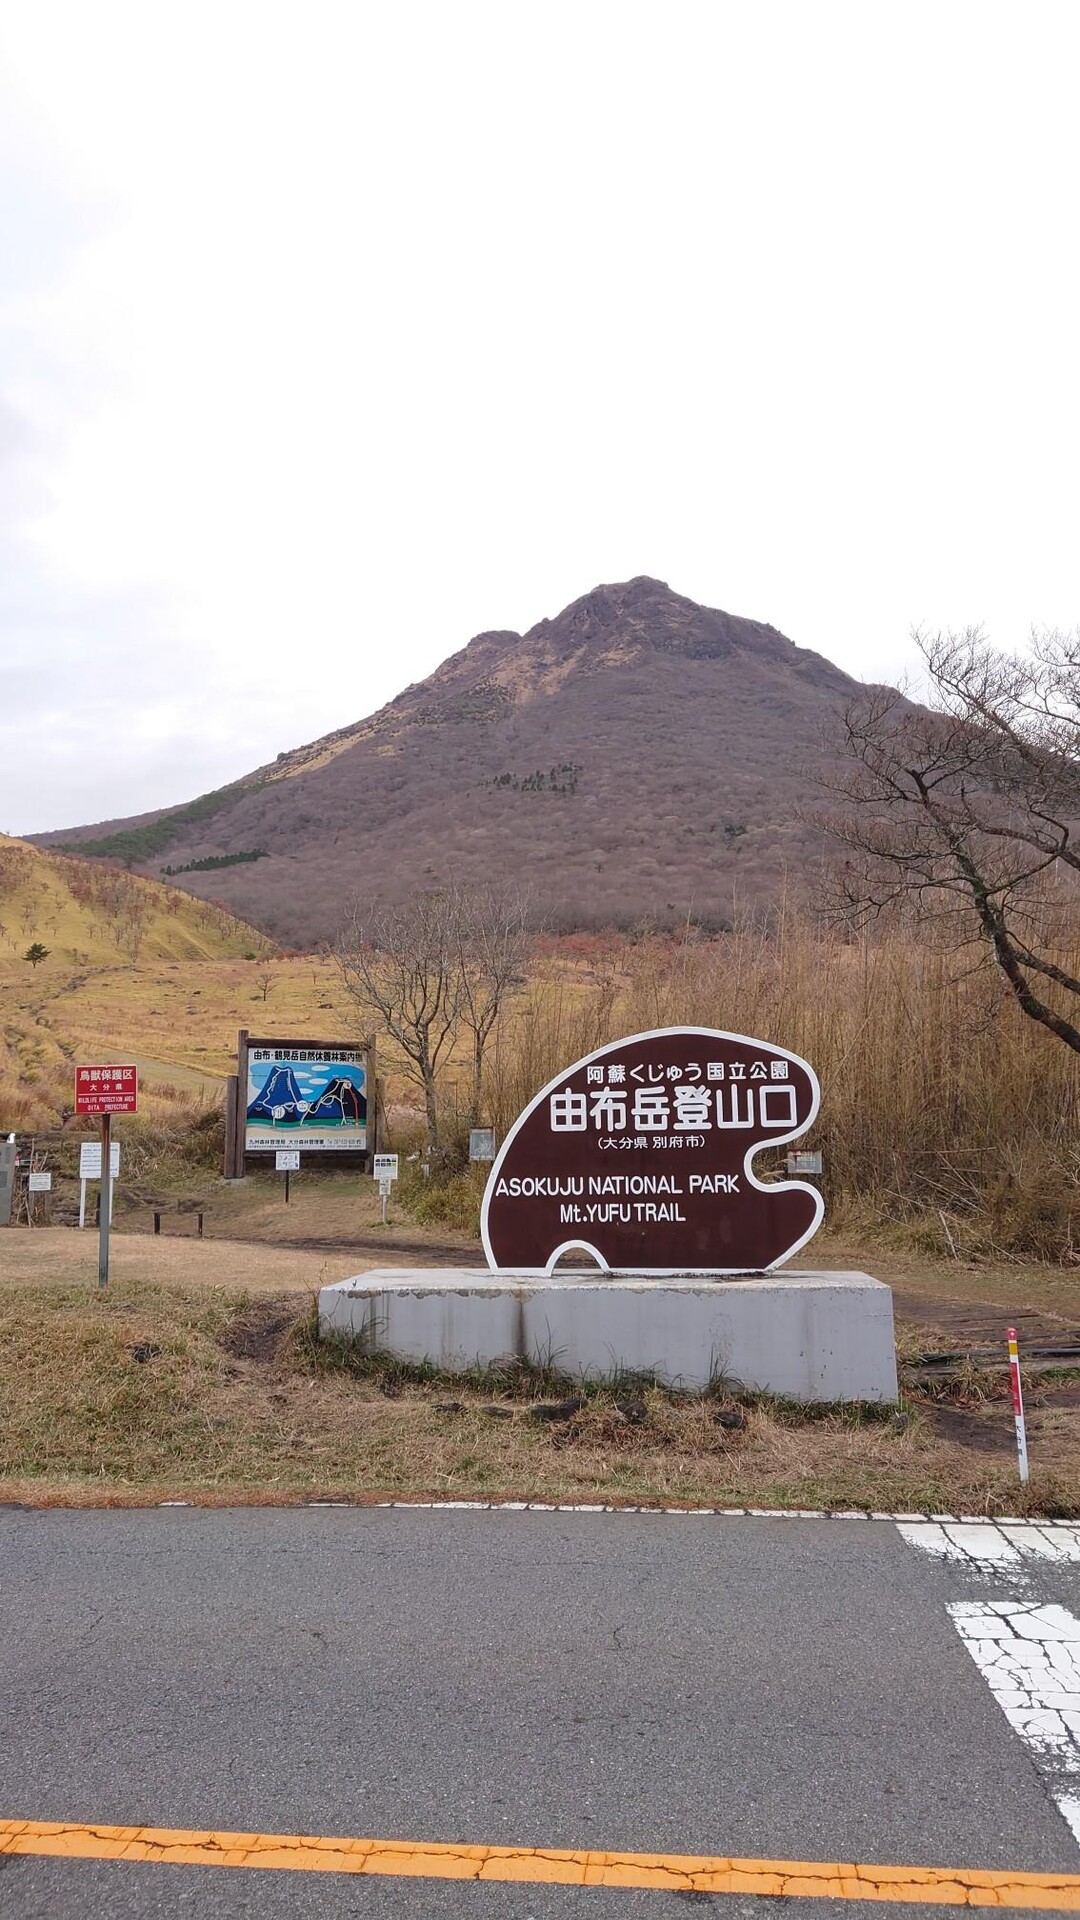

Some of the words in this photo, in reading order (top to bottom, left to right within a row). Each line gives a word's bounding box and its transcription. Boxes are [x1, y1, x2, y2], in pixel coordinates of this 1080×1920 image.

[80, 1069, 133, 1081] 鳥獣保護区
[587, 1061, 789, 1084] 阿蘇くじゅう国立公園
[550, 1084, 798, 1132] 由布岳登山口
[495, 1176, 584, 1197] ASOKUJU
[588, 1175, 683, 1196] NATIONAL
[689, 1174, 740, 1194] PARK
[560, 1203, 631, 1223] Mt.YUFU
[634, 1202, 686, 1222] TRAIL
